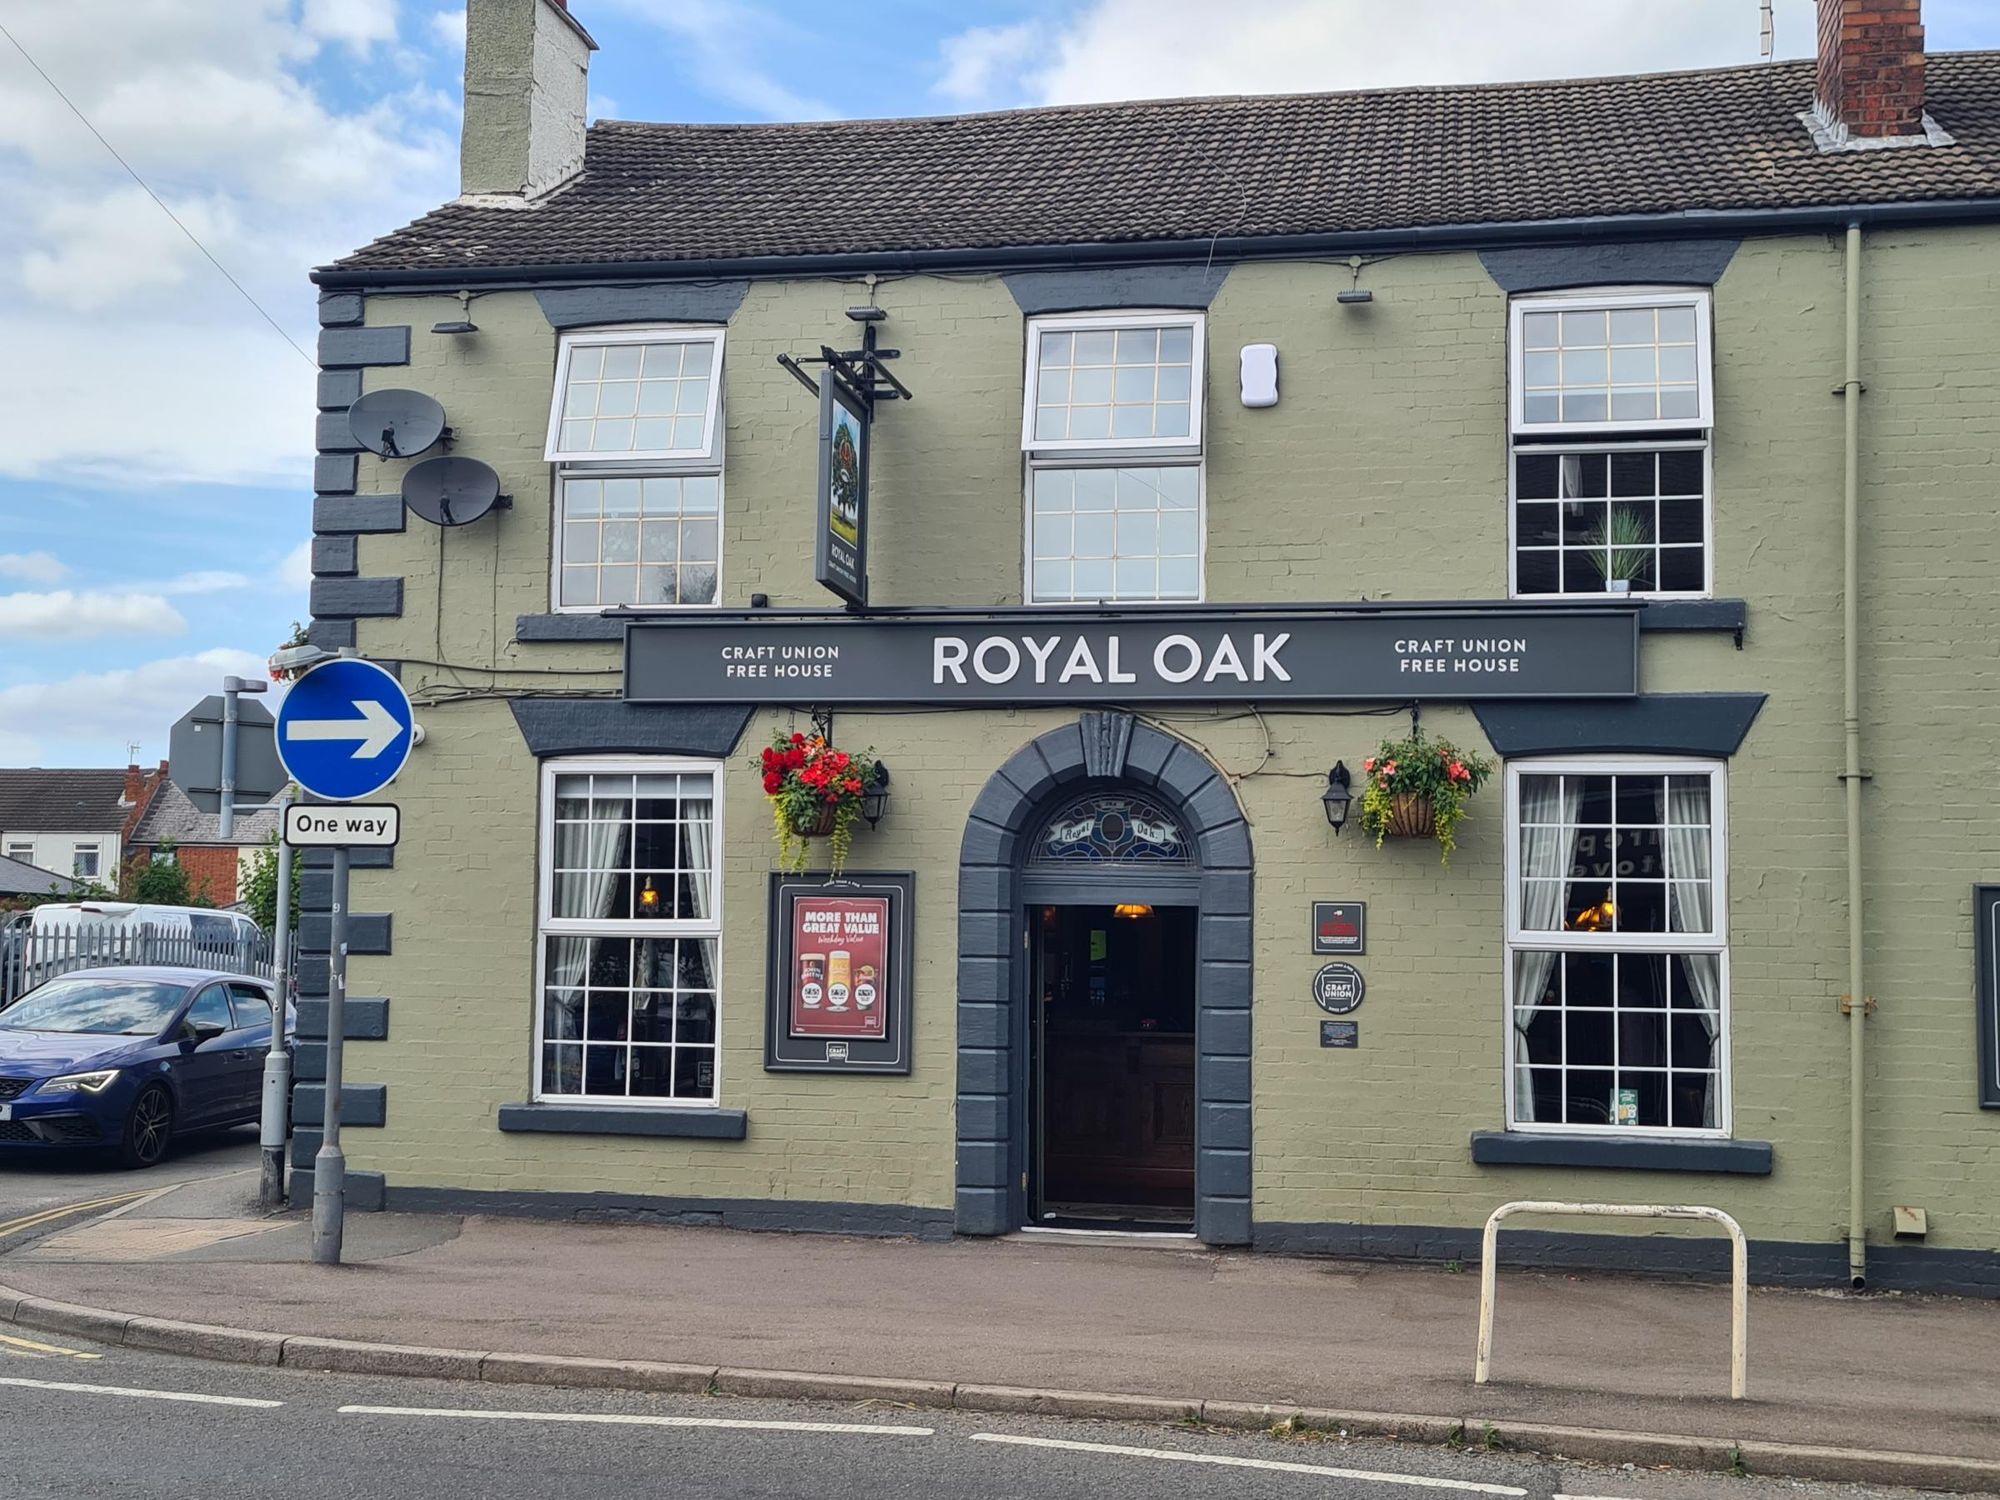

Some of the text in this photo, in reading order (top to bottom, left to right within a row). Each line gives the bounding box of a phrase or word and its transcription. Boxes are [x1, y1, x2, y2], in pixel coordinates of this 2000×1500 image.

[721, 646, 839, 659] CRAFT UNION
[1394, 639, 1526, 653] CRAFT UNION
[933, 633, 1292, 684] ROYAL OAK
[1400, 658, 1520, 672] FREE HOUSE
[726, 665, 832, 677] FREE HOUSE
[297, 815, 388, 836] One way
[1064, 823, 1090, 840] Royal
[805, 911, 878, 923] MORE THAN
[802, 922, 880, 934] GREAT VALUE
[1325, 990, 1352, 998] UNION
